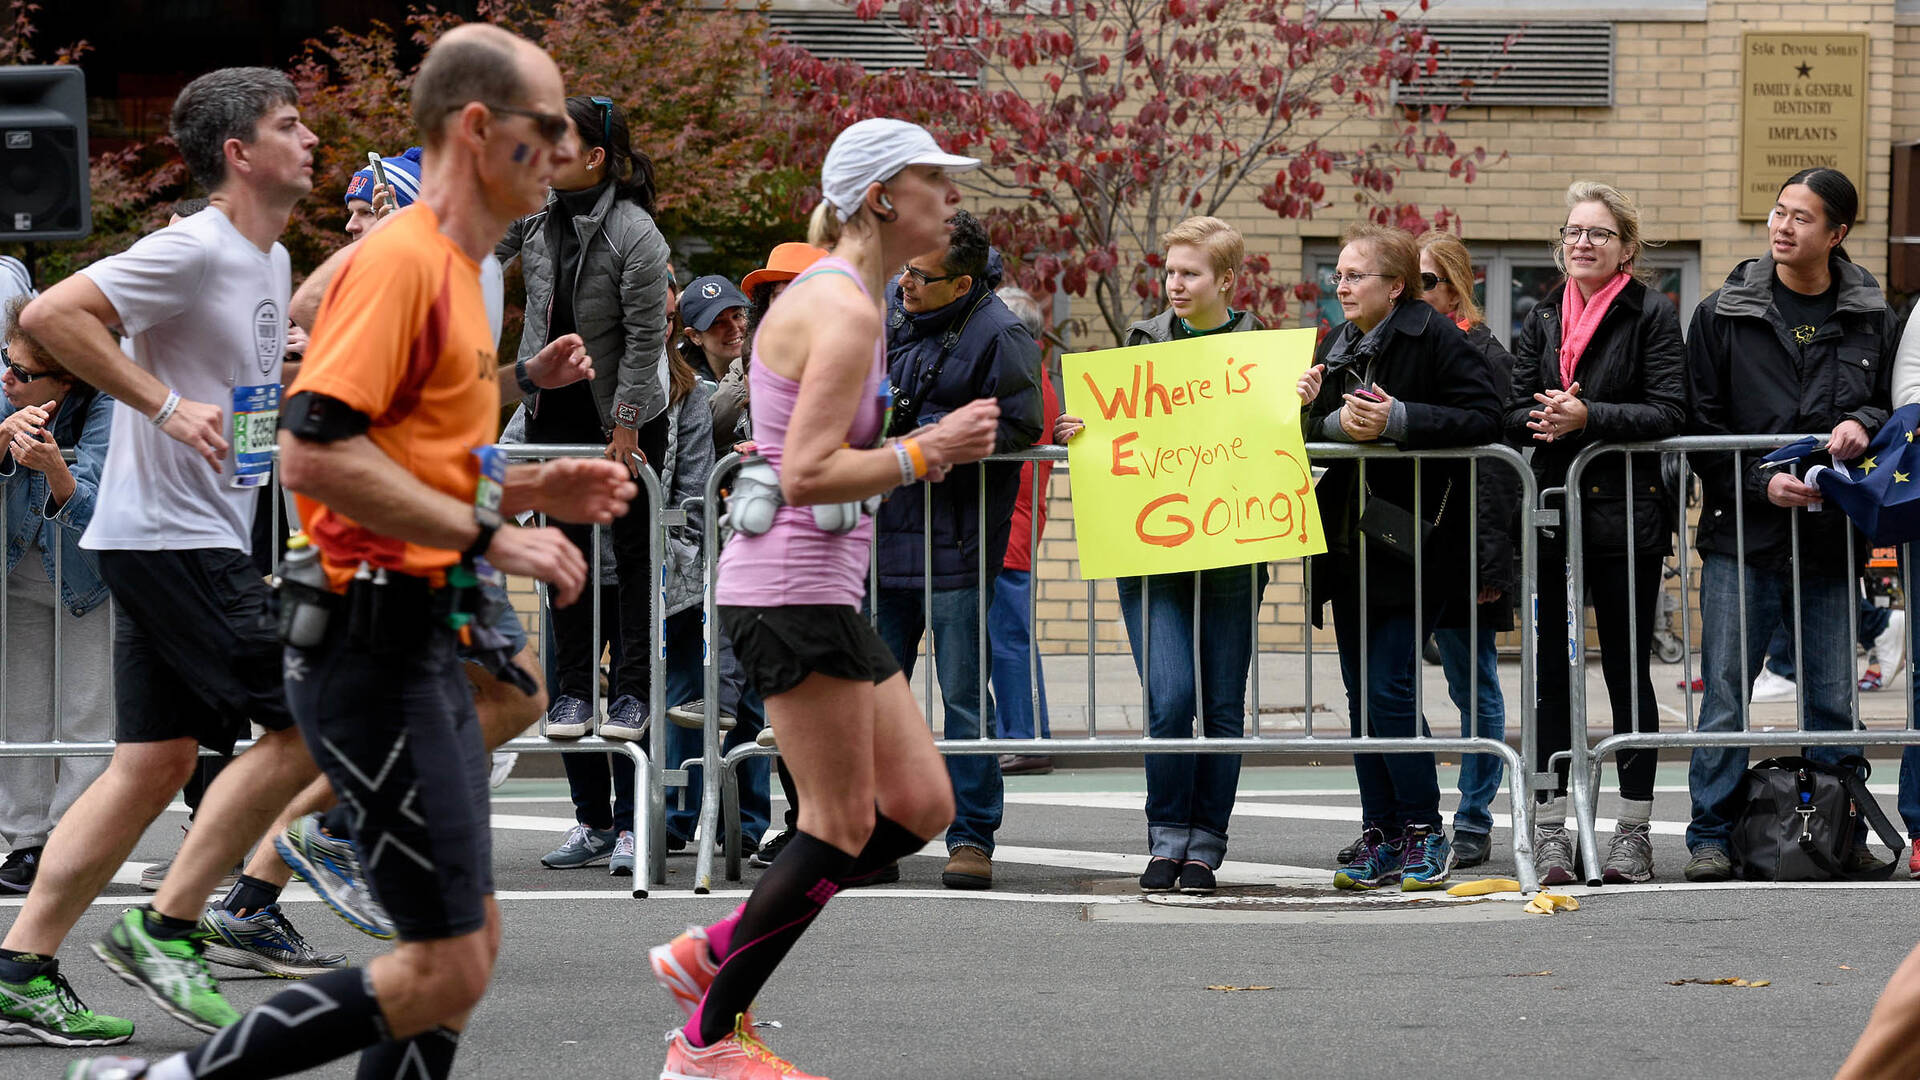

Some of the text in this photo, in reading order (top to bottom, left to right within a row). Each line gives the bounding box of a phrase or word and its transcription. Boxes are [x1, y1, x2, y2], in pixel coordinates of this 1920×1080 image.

[1781, 42, 1818, 56] DENTAL
[1753, 83, 1855, 98] FAMILY & GENERAL
[1773, 101, 1833, 115] DENTISTRY
[1768, 126, 1838, 140] IMPLANTS
[1766, 154, 1838, 169] WHITENING
[1082, 357, 1258, 420] Where is
[1110, 431, 1248, 487] Everyone
[1135, 449, 1310, 548] Going?
